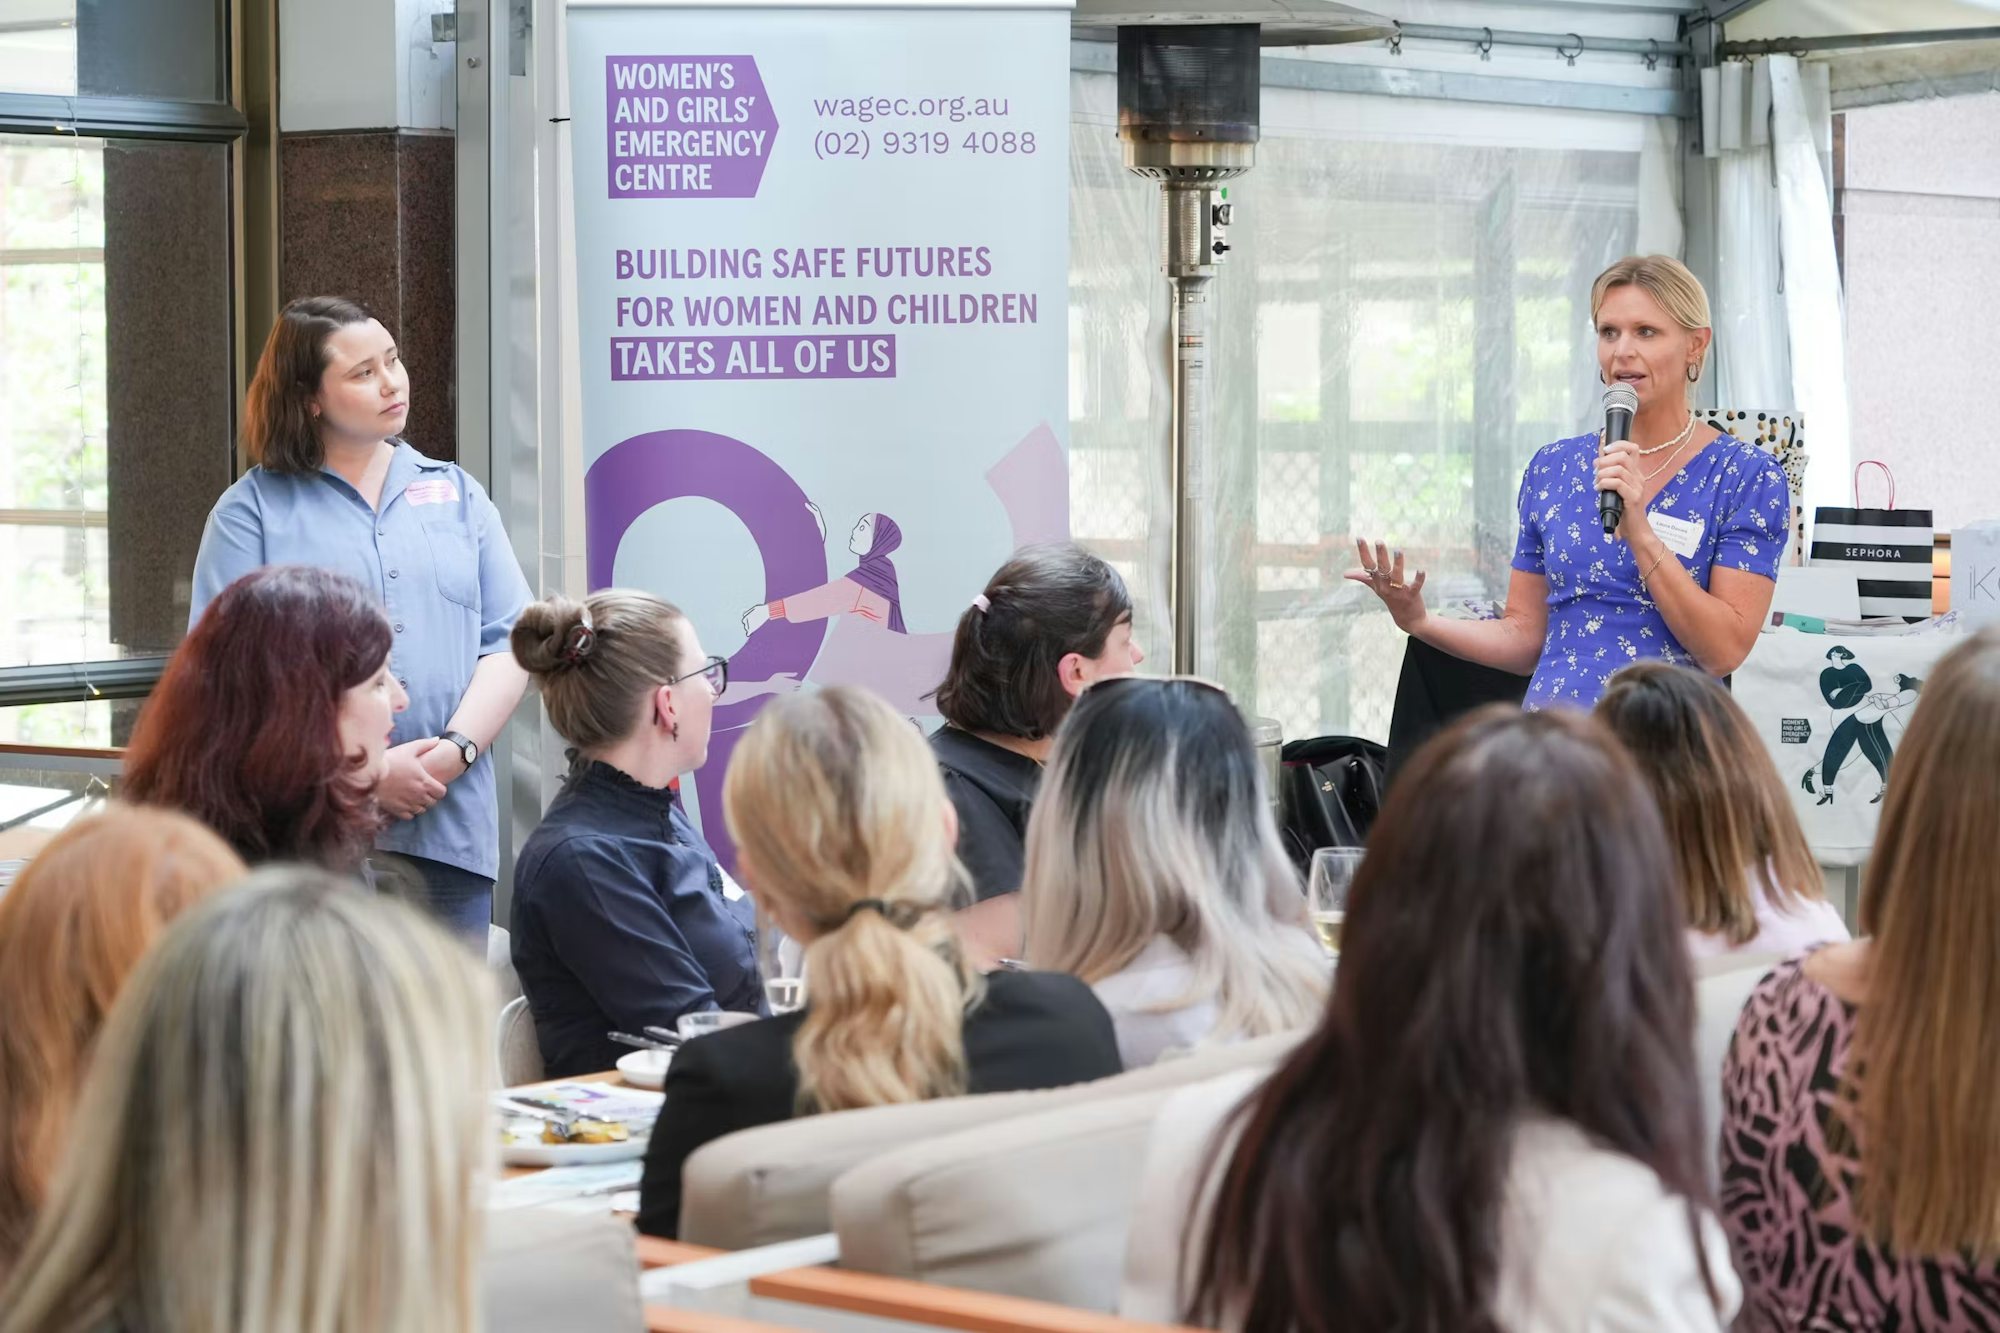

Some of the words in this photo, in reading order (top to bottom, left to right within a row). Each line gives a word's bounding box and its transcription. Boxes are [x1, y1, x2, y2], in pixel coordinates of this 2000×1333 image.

[613, 62, 735, 90] WOMEN'S
[614, 97, 669, 123] AND
[676, 96, 756, 123] GIRLS'
[813, 95, 1009, 122] wagec.org.au
[615, 130, 766, 157] EMERGENCY
[814, 130, 870, 160] (02)
[883, 131, 950, 155] 9319
[961, 131, 1036, 154] 4088
[615, 164, 713, 190] CENTRE
[616, 248, 762, 280] BUILDING
[772, 247, 846, 279] SAFE
[857, 246, 992, 278] FUTURES
[616, 296, 675, 328] FOR
[683, 295, 802, 327] WOMEN
[811, 294, 877, 325] AND
[887, 293, 1037, 325] CHILDREN
[615, 341, 715, 374] TAKES
[724, 340, 784, 374] ALL
[793, 339, 836, 373] OF
[846, 339, 891, 373] US
[1845, 547, 1901, 559] SEPHORA
[1969, 564, 2000, 600] iK
